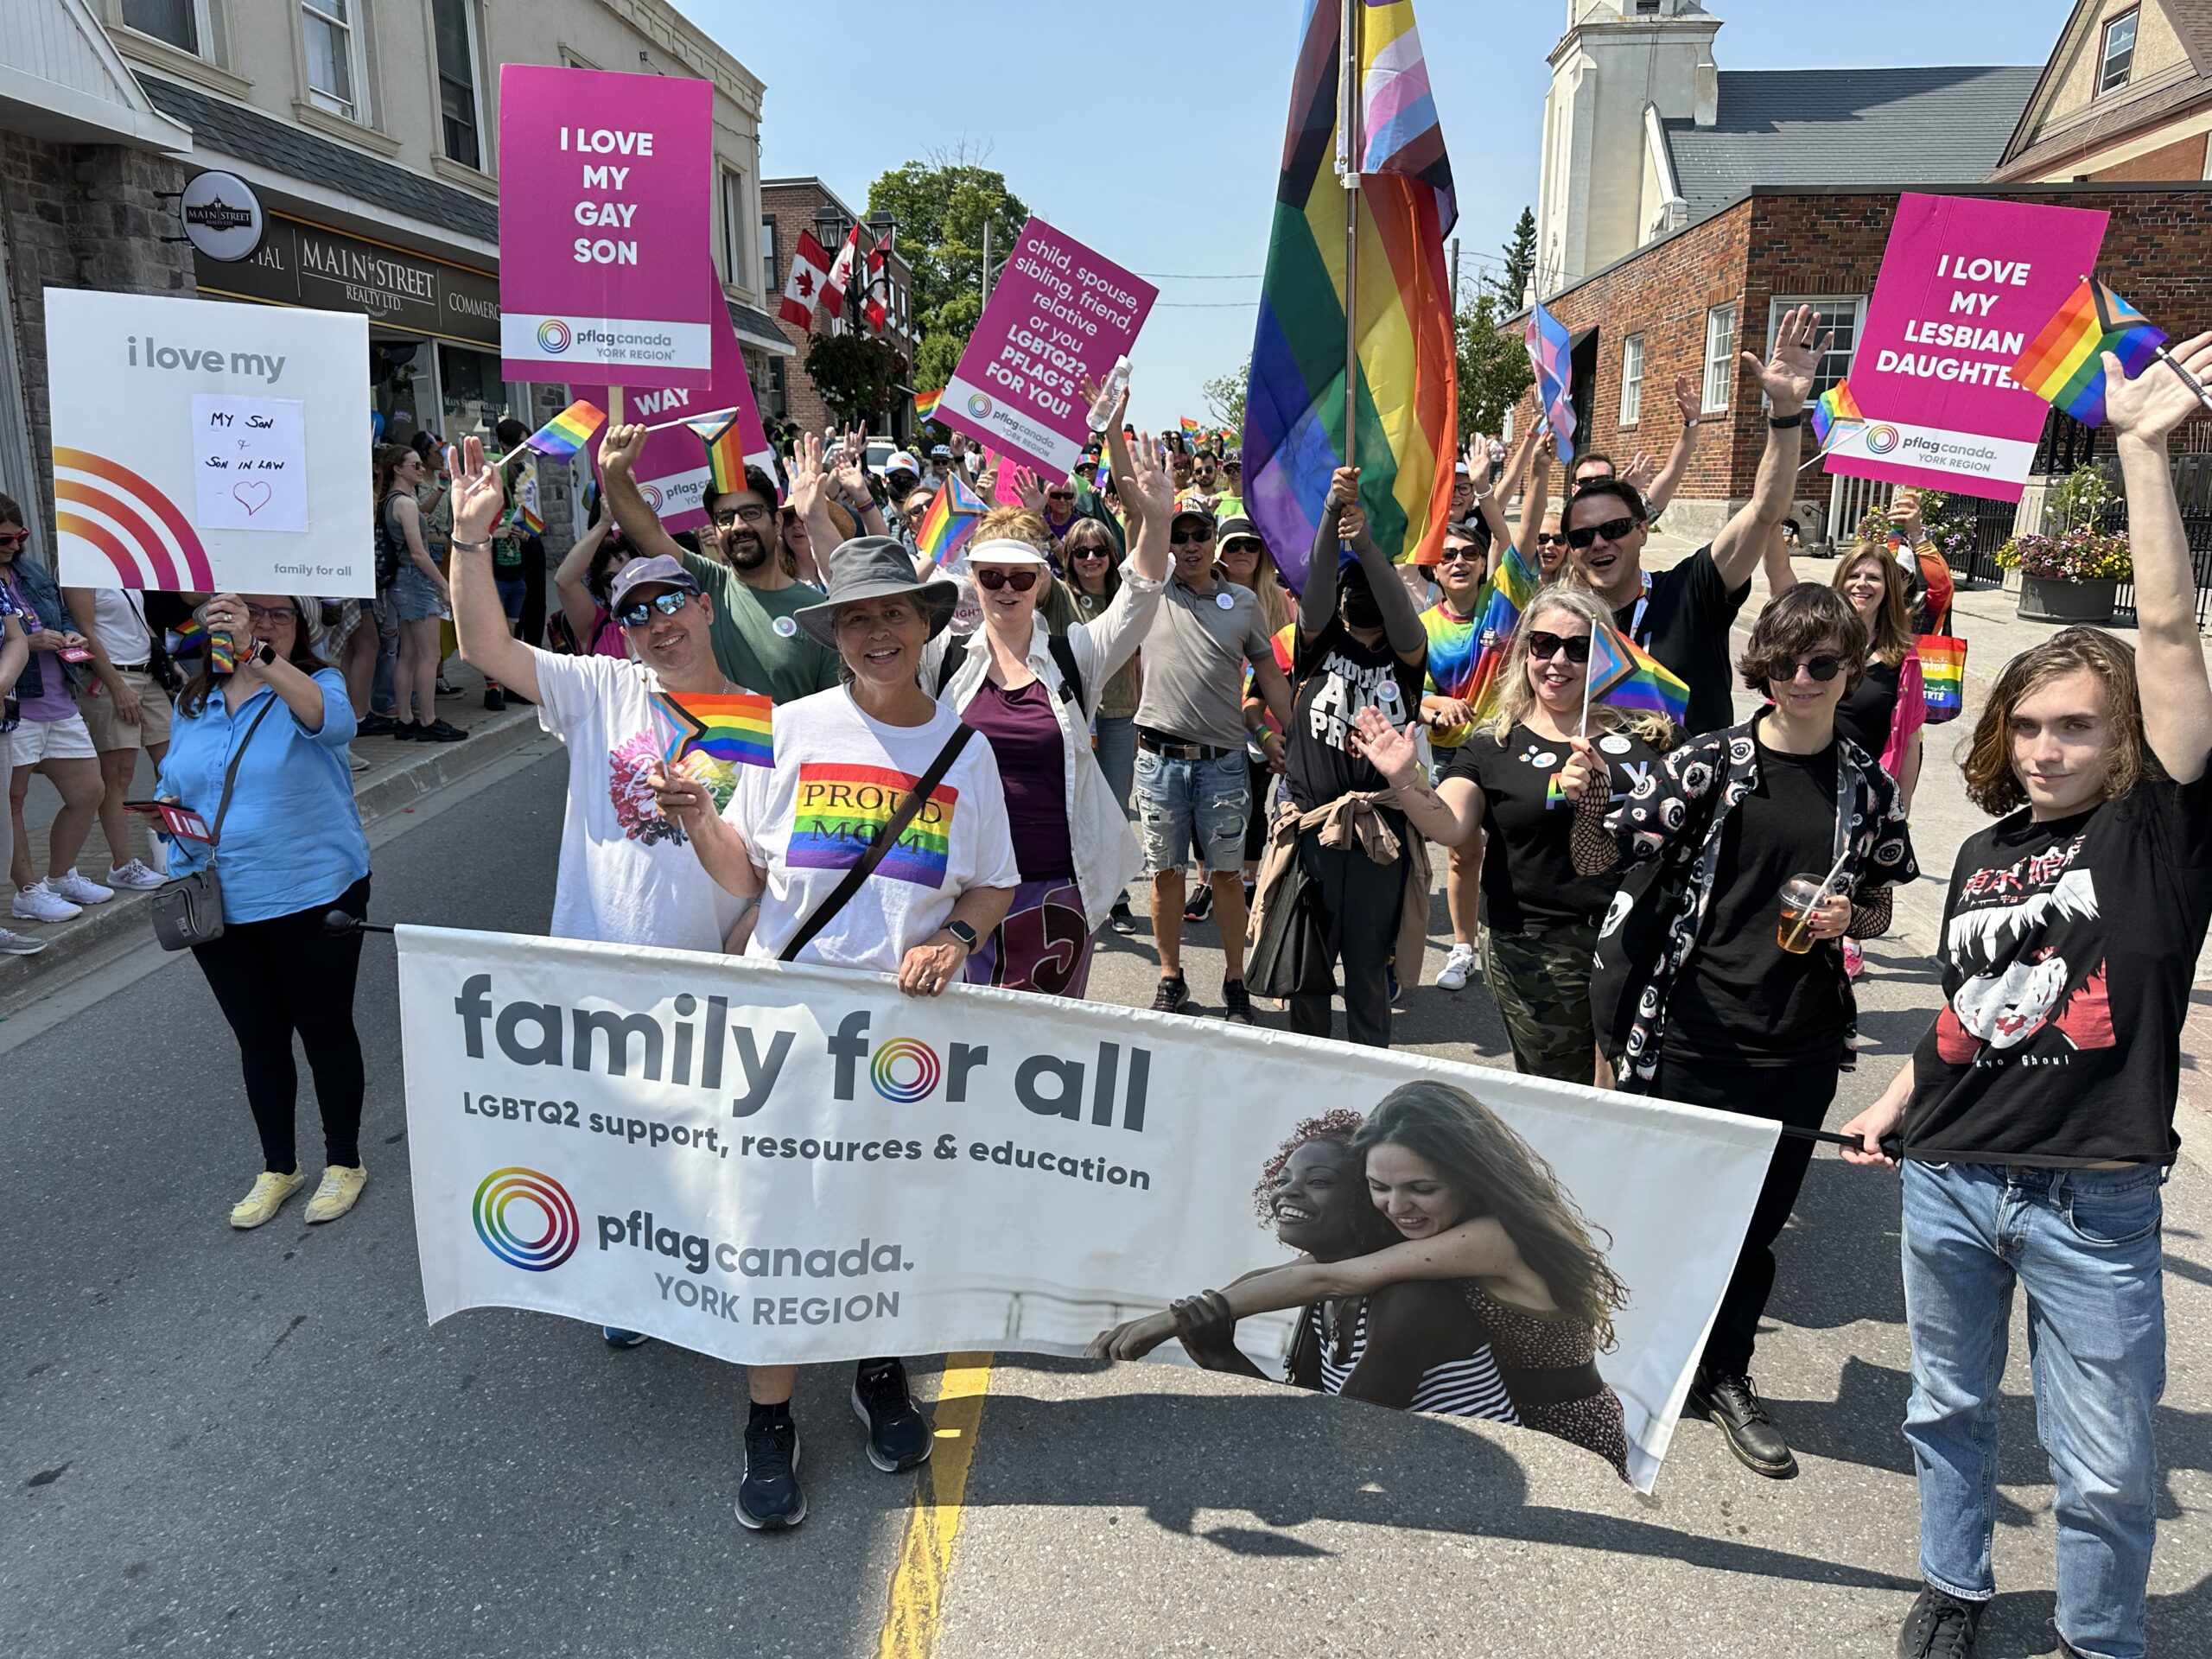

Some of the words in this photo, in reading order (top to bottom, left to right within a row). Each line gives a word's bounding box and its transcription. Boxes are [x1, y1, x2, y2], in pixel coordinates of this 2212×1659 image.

[561, 127, 568, 150] I
[577, 128, 653, 156] LOVE
[583, 165, 630, 190] MY
[188, 210, 216, 219] MAIN
[219, 212, 250, 221] STREET
[574, 200, 638, 228] GAY
[574, 238, 638, 265] SON
[303, 238, 367, 282] MAIN
[377, 259, 435, 299] STREET
[448, 292, 500, 322] COMMERC
[1027, 238, 1071, 275] child,
[1077, 267, 1140, 315] spouse,
[1936, 254, 1949, 276] I
[1952, 256, 2031, 286] LOVE
[346, 284, 383, 308] REALTY
[382, 293, 404, 312] LTD.
[1014, 257, 1074, 302] sibling,
[1079, 291, 1131, 335] friend,
[1948, 290, 2000, 317] MY
[1033, 292, 1097, 336] relative
[1029, 315, 1049, 333] or
[1049, 327, 1084, 353] you
[1904, 320, 2024, 355] LESBIAN
[128, 335, 137, 366] i
[145, 337, 225, 372] love
[231, 353, 286, 385] my
[596, 348, 626, 359] YORK
[630, 349, 672, 361] REGION
[1007, 324, 1087, 378] LGBTQ2?
[1000, 345, 1075, 397] PFLAG'S
[633, 388, 690, 416] WAY
[985, 361, 1025, 394] FOR
[1027, 383, 1072, 419] YOU!
[211, 412, 234, 427] MY
[1002, 428, 1022, 442] YORK
[1022, 438, 1050, 457] REGION
[238, 460, 253, 470] IN
[257, 460, 284, 470] LAW
[1918, 453, 1947, 466] YORK
[1948, 458, 1991, 473] REGION
[273, 563, 313, 577] family
[315, 565, 334, 575] for
[336, 566, 352, 576] all
[953, 608, 982, 618] IGHT
[1923, 690, 1945, 702] ERTÉ
[1545, 760, 1649, 810] ALY
[810, 820, 924, 855] MOM
[454, 973, 797, 1118] family
[827, 1010, 988, 1104] for
[1014, 1040, 1152, 1133] all
[2022, 1054, 2069, 1067] Ghoul
[463, 1091, 581, 1128] LGBTQ2
[589, 1112, 729, 1159] support,
[741, 1135, 923, 1162] resources
[933, 1133, 958, 1160] &
[969, 1141, 1151, 1192] education
[654, 1272, 741, 1324] YORK
[753, 1291, 899, 1325] REGION
